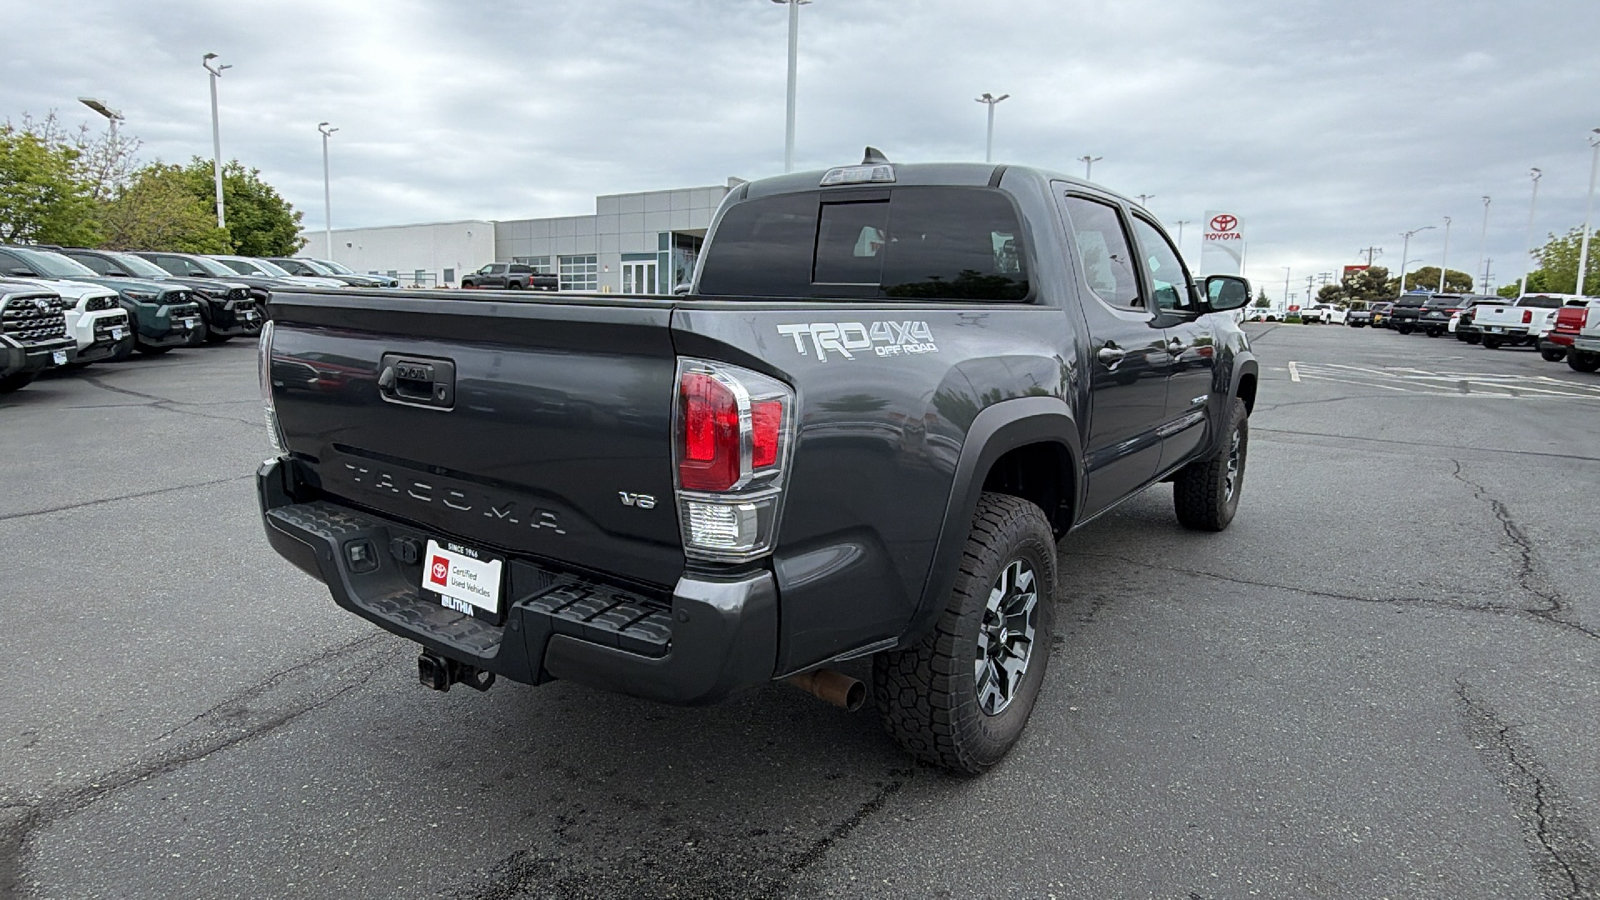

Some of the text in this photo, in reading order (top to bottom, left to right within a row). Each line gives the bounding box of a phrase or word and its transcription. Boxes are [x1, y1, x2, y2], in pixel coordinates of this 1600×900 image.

[1204, 232, 1241, 240] TOYOTA
[777, 322, 873, 362] TRD
[874, 343, 938, 357] OFF ROAD
[344, 462, 567, 535] TACOMA
[618, 491, 657, 509] V6
[447, 542, 464, 554] SINCE
[452, 566, 477, 580] Certified
[451, 577, 490, 597] Used Vehicles
[448, 596, 474, 617] LITHIA
